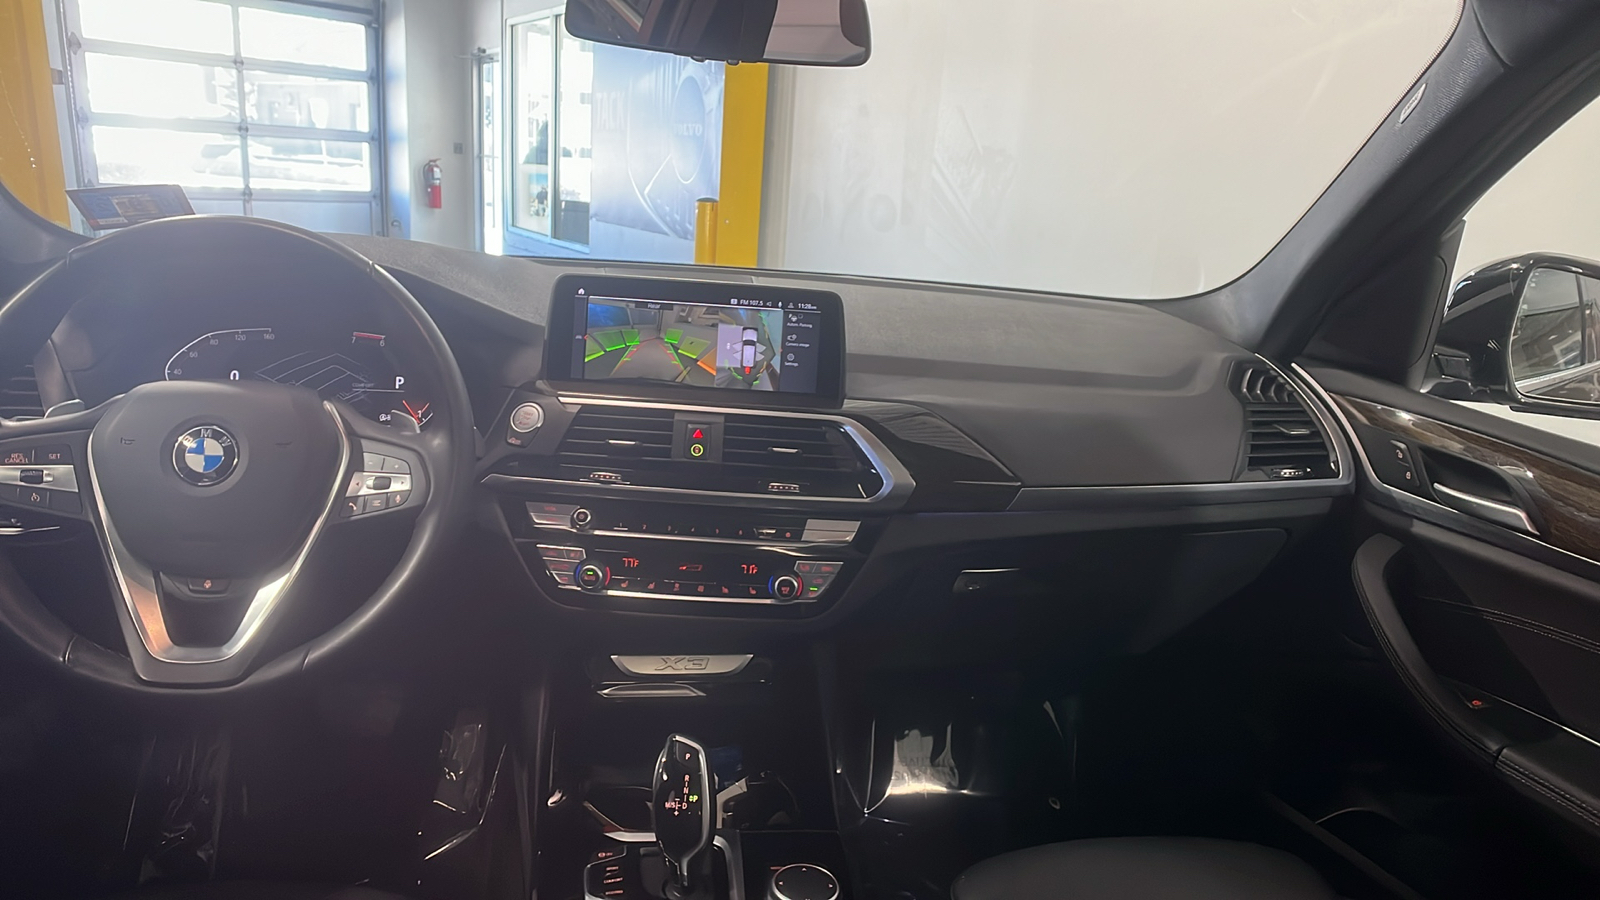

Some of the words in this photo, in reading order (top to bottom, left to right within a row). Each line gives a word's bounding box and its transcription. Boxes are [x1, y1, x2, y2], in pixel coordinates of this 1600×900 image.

[673, 123, 704, 136] VOLVO
[395, 376, 405, 389] P
[654, 657, 710, 671] X3
[685, 752, 692, 761] P
[684, 774, 690, 782] R
[683, 786, 689, 794] N
[681, 802, 688, 810] D
